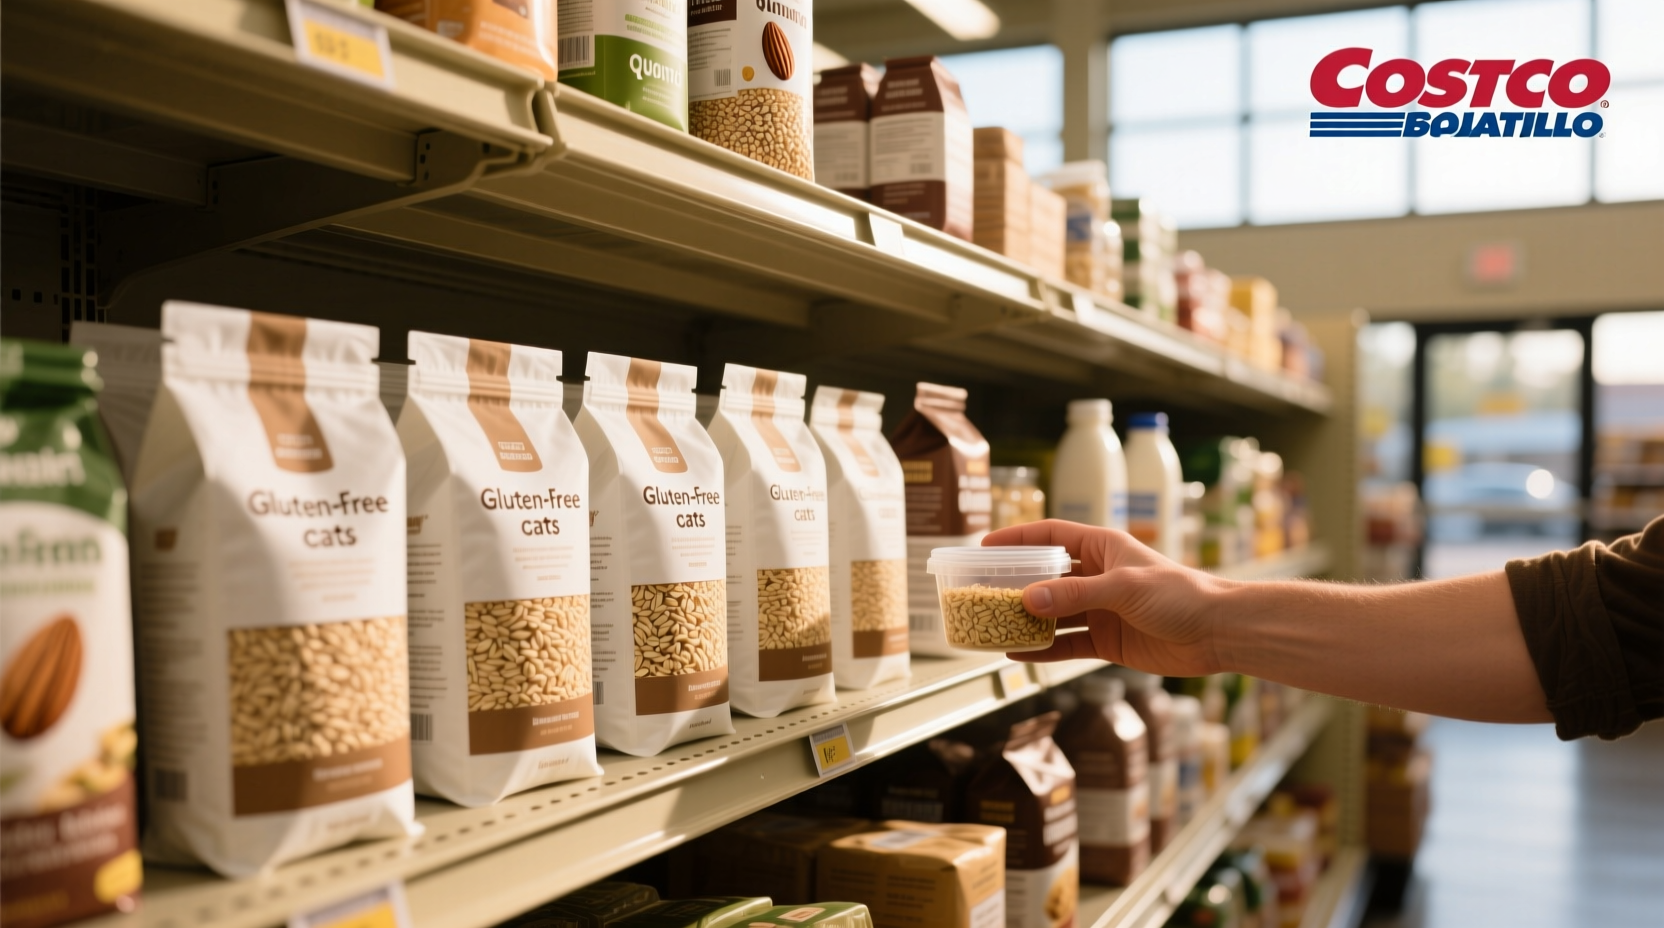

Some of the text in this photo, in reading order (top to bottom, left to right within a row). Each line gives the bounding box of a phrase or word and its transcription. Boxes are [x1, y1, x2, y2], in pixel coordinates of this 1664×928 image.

[249, 490, 388, 517] Gluten-Free
[481, 487, 581, 510] Gluten-Free
[643, 485, 720, 505] Gluten-Free
[521, 516, 560, 536] cats
[676, 512, 706, 528] cats
[303, 525, 357, 548] cats
